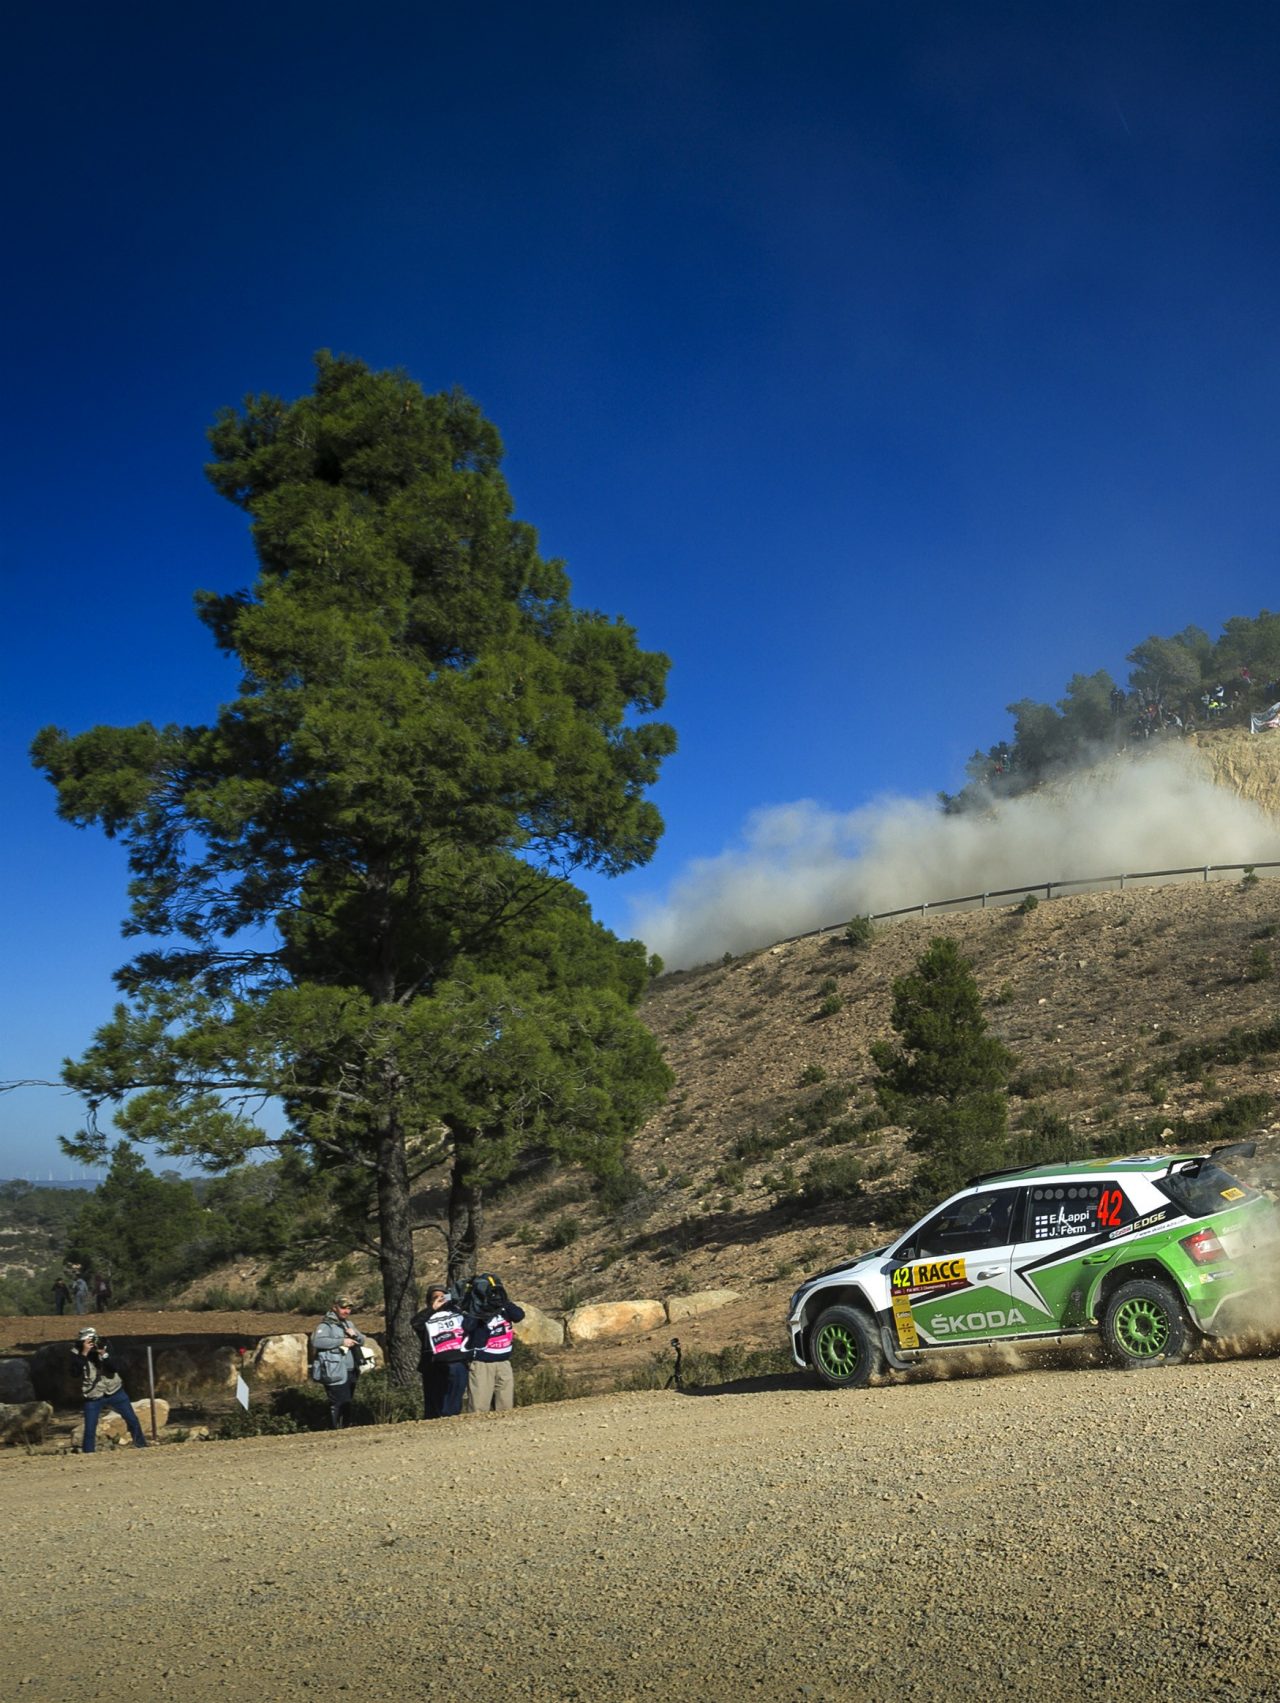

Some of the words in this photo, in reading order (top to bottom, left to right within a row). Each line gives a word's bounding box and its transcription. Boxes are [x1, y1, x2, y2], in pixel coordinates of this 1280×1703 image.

[1096, 1190, 1123, 1226] 42
[1060, 1225, 1087, 1235] Ferm
[1133, 1210, 1166, 1230] EDGE
[893, 1267, 911, 1288] 42
[918, 1260, 961, 1283] RACC
[444, 1320, 454, 1328] 10
[930, 1308, 1027, 1335] ŠKODA
